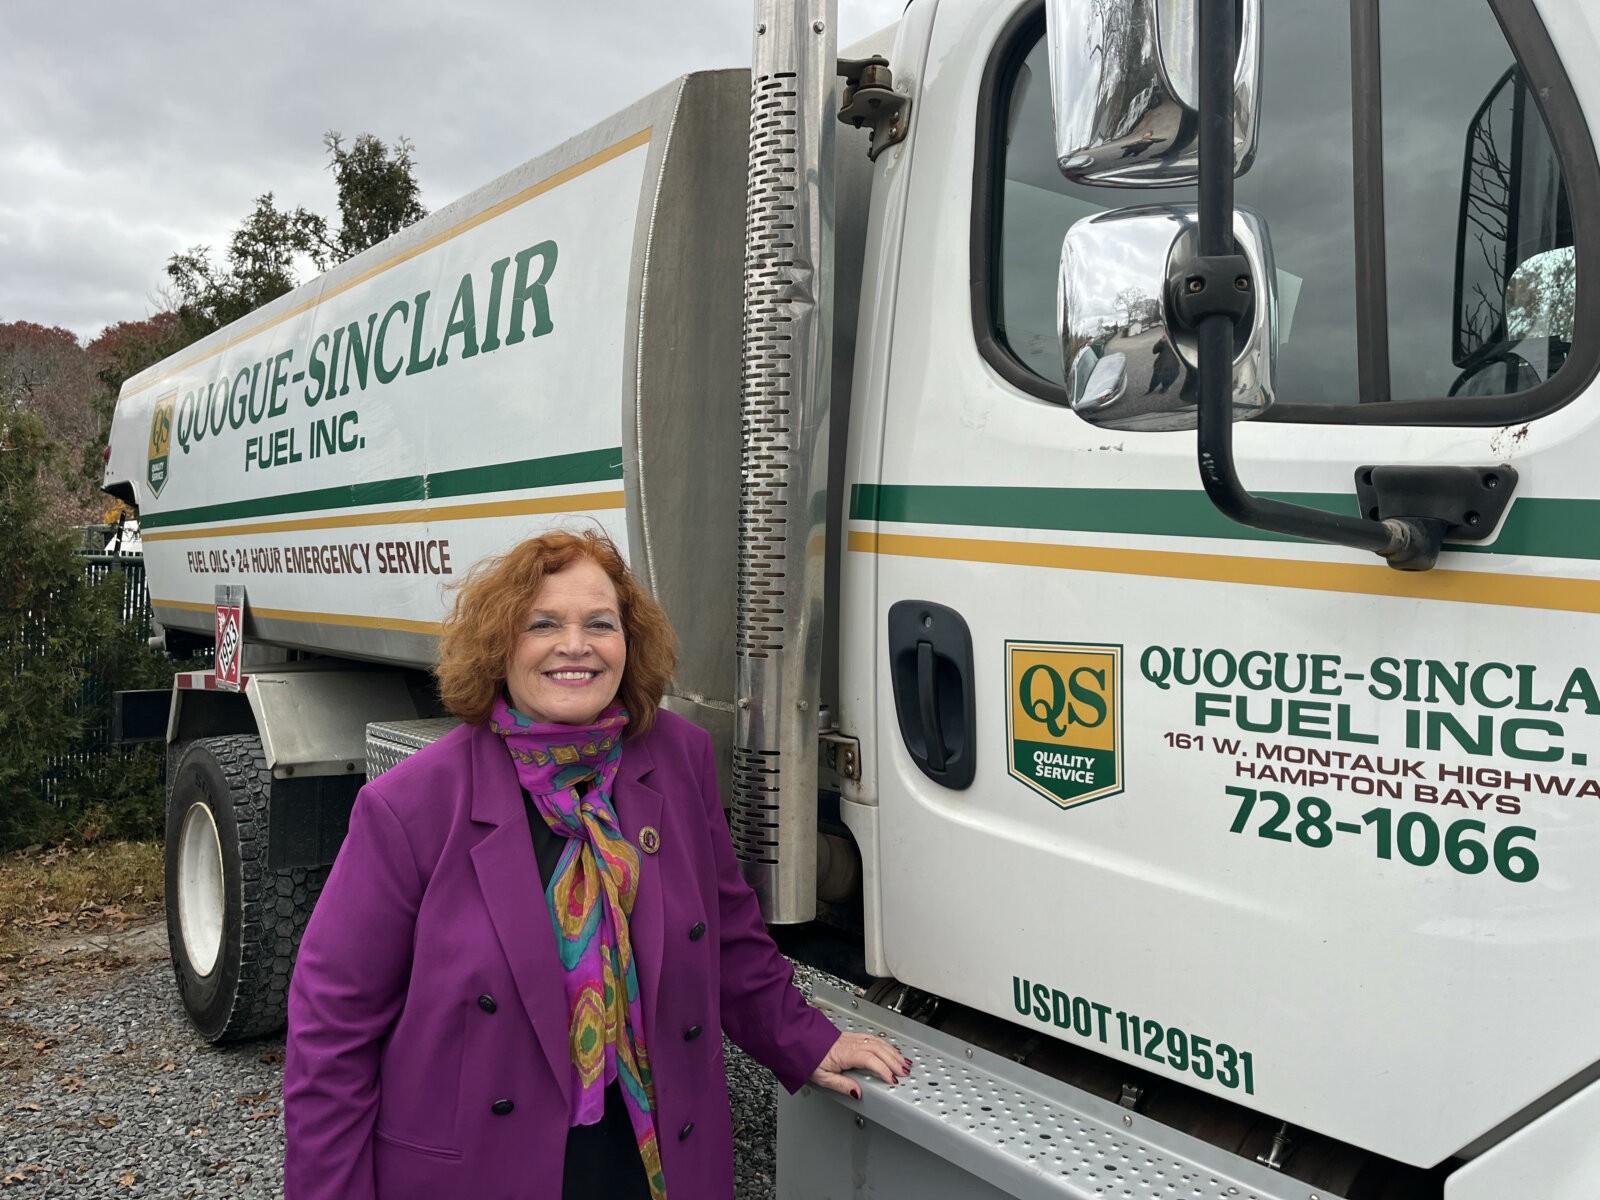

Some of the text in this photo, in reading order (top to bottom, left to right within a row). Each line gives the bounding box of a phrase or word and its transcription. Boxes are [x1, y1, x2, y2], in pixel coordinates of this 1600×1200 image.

[177, 240, 558, 454] QUOGUE-SINCLAIR
[245, 410, 365, 472] FUEL INC.
[187, 540, 452, 575] FUEL OILS 24 HOUR EMERGENCY SERVICE
[220, 620, 237, 673] 1993
[1140, 645, 1600, 716] QUOGUE-SINCLA
[1019, 664, 1107, 737] QS
[1195, 692, 1588, 766] FUEL INC.
[1033, 750, 1095, 769] QUALITY
[1035, 764, 1095, 784] SERVICE
[1163, 732, 1600, 801] 161 W. MONTAUK HIGHWA
[1235, 760, 1521, 815] HAMPTON BAYS
[1224, 786, 1540, 883] 728-1066
[1012, 976, 1255, 1096] USDOT 1129531
